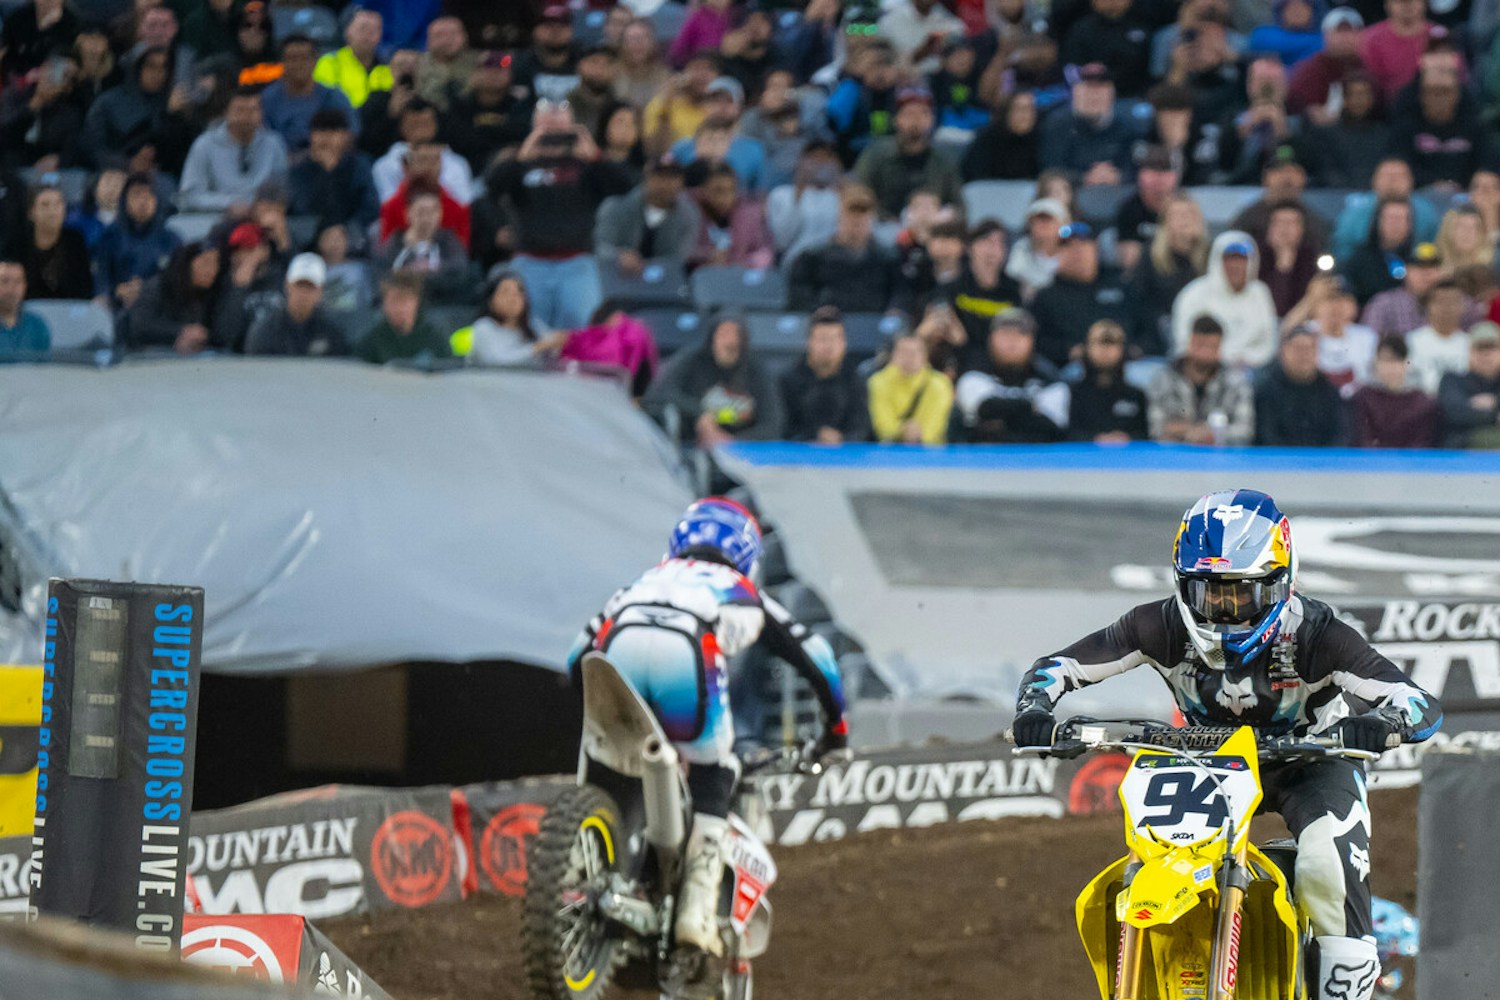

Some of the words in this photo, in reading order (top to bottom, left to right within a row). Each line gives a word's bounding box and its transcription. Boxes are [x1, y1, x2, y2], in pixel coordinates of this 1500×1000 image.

[134, 603, 194, 958] SUPERCROSSLIVE.CO
[809, 757, 1060, 808] MOUNTAIN
[1136, 771, 1232, 829] 94
[186, 817, 358, 874] OUNTAIN
